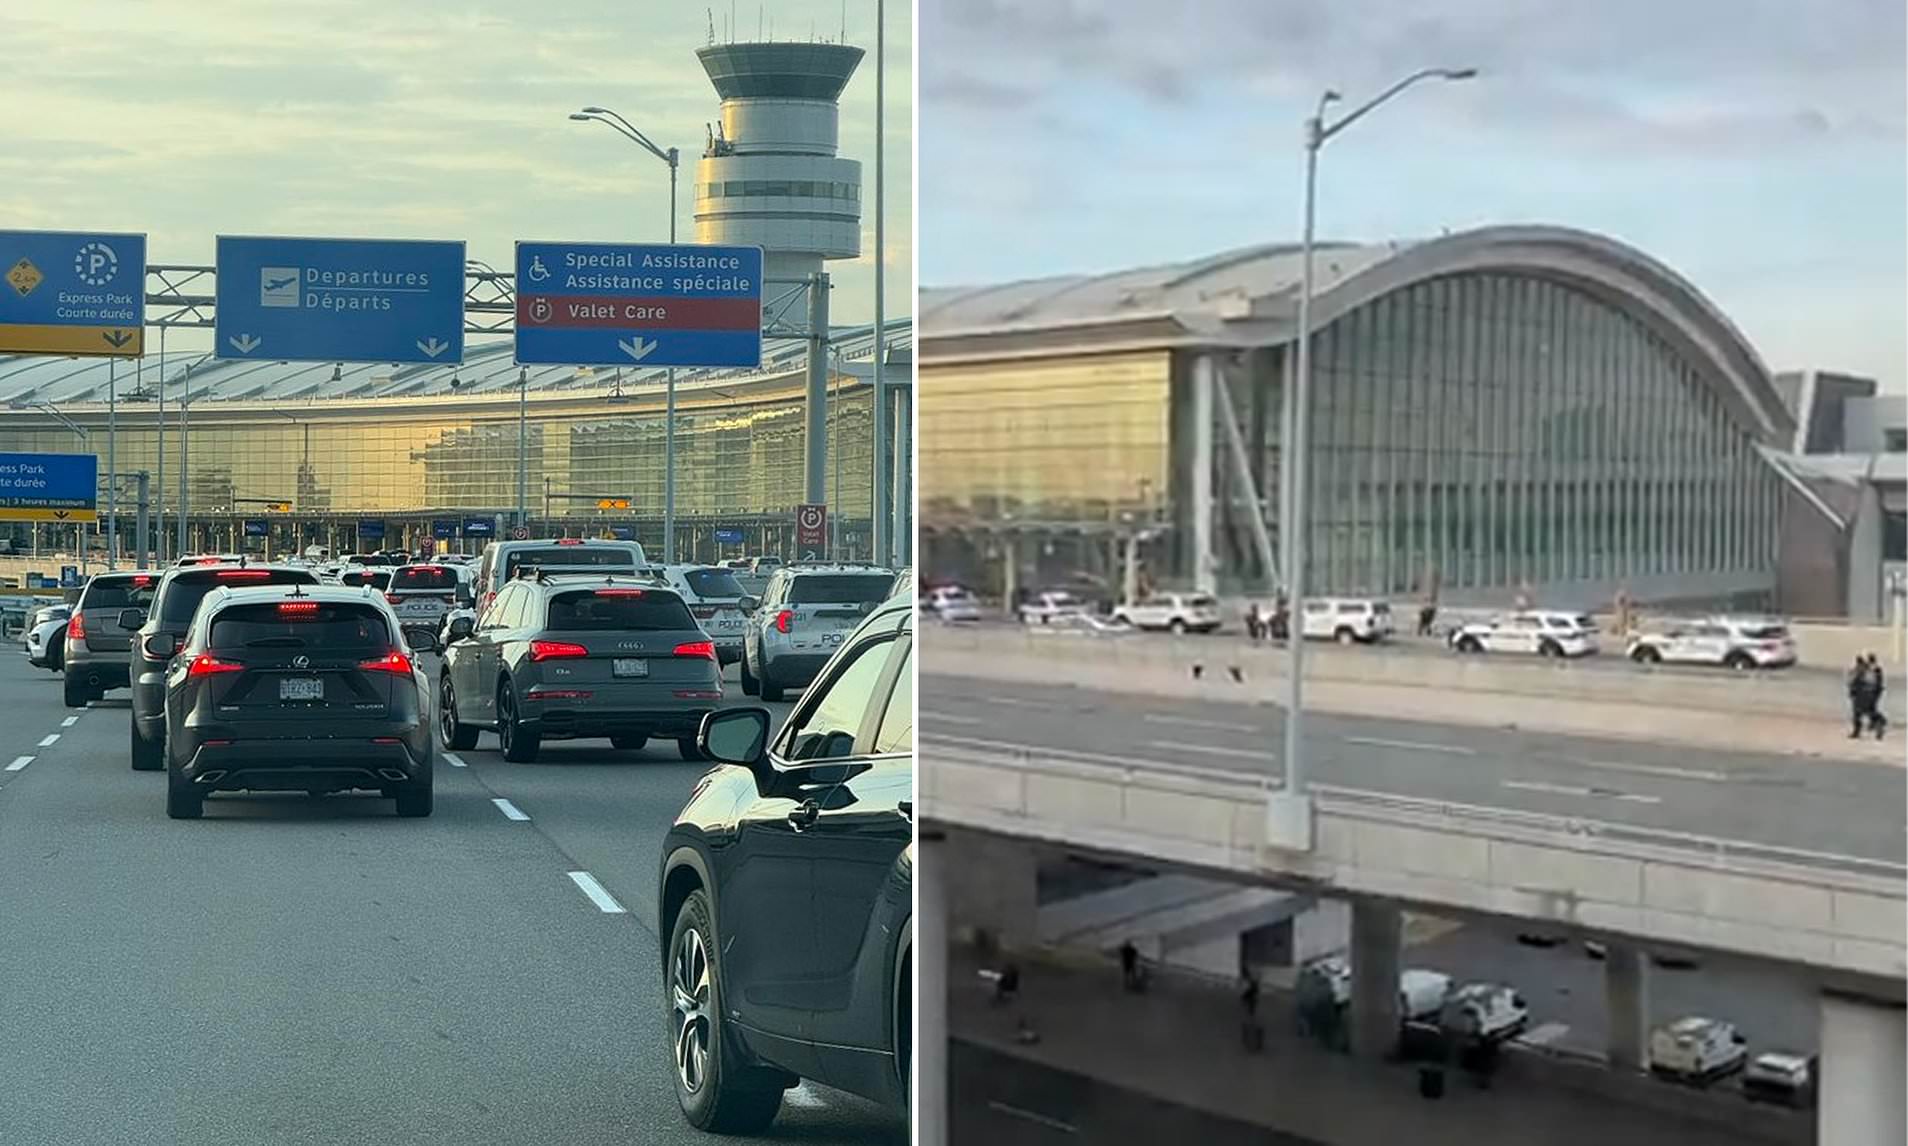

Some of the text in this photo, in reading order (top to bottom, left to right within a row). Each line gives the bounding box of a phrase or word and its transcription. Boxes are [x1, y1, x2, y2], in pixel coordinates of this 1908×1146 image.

[90, 254, 105, 275] P
[566, 253, 740, 269] Special Assistance
[306, 268, 429, 287] Departures
[566, 275, 750, 293] Assistance spéciale
[58, 292, 133, 305] Express Park
[306, 293, 391, 312] Départs
[56, 307, 134, 319] Courte durée
[536, 304, 546, 317] P
[569, 304, 667, 320] Valet Care
[20, 464, 46, 474] Park
[14, 478, 47, 488] durée
[807, 512, 817, 524] P
